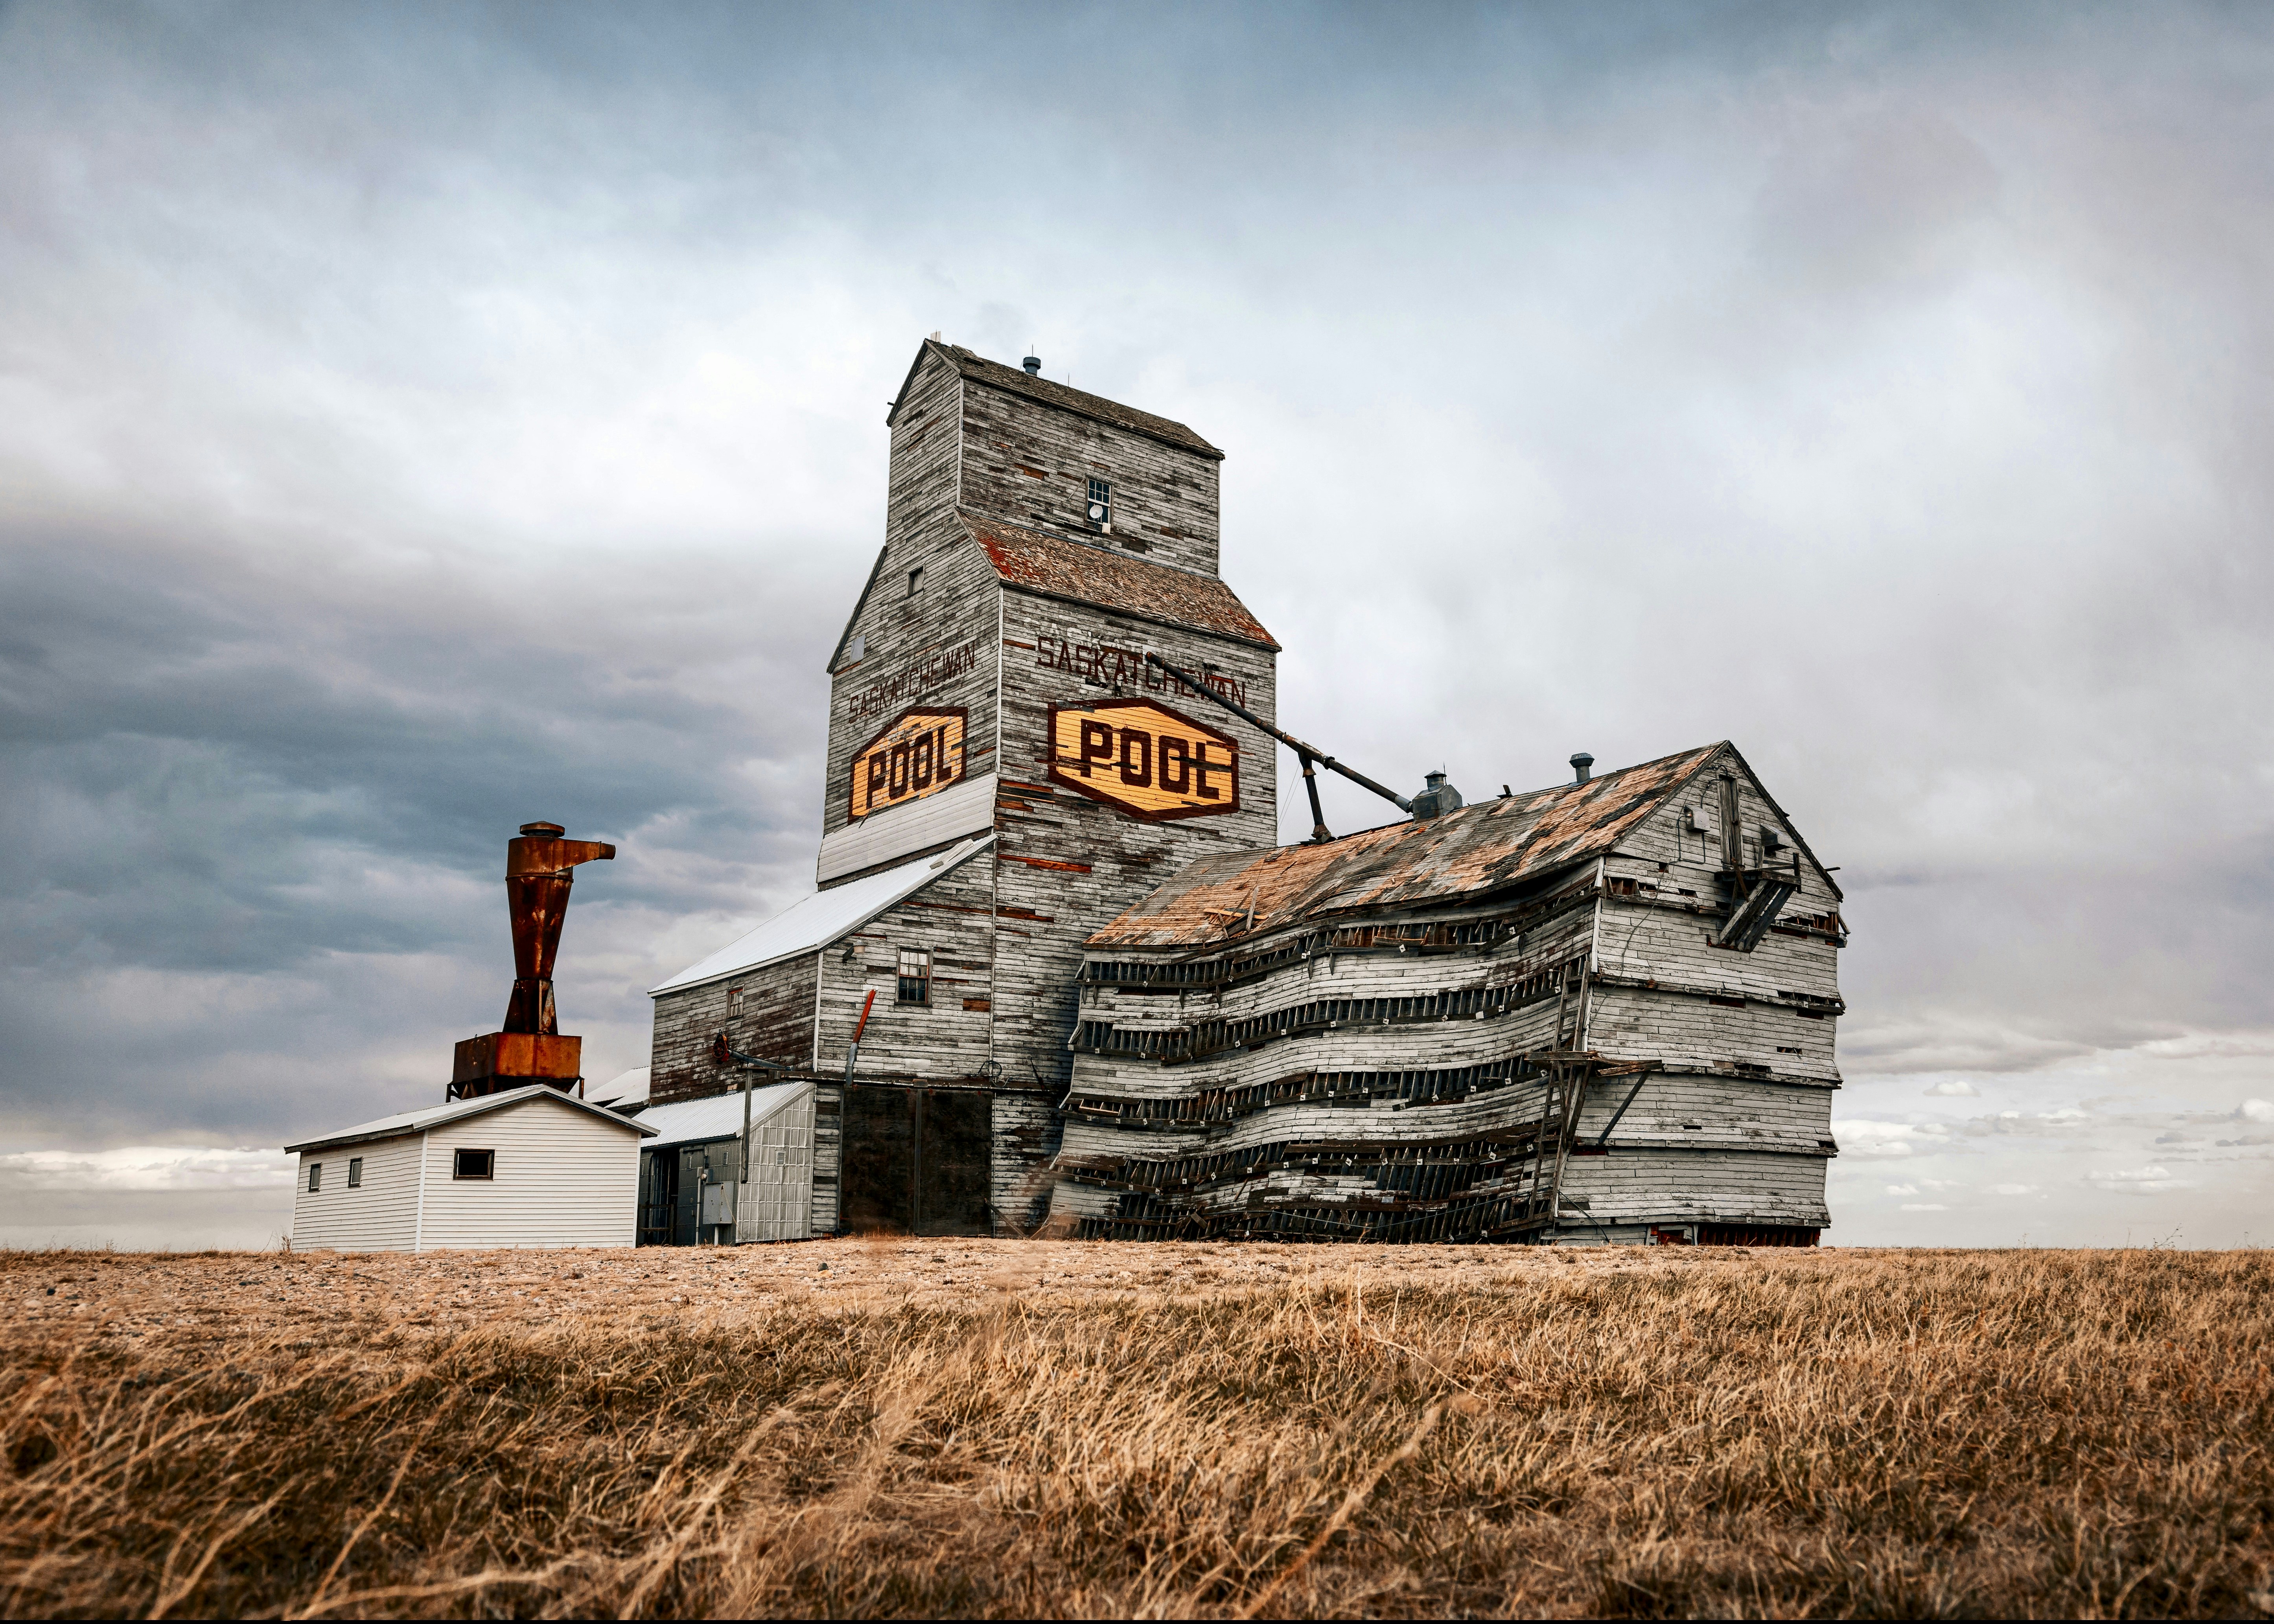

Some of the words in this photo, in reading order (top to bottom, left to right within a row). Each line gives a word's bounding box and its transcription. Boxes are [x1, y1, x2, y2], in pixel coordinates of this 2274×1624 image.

[849, 640, 975, 723] SASKATCHEWAN
[866, 727, 952, 809] POOL
[1081, 719, 1219, 800] POOL
